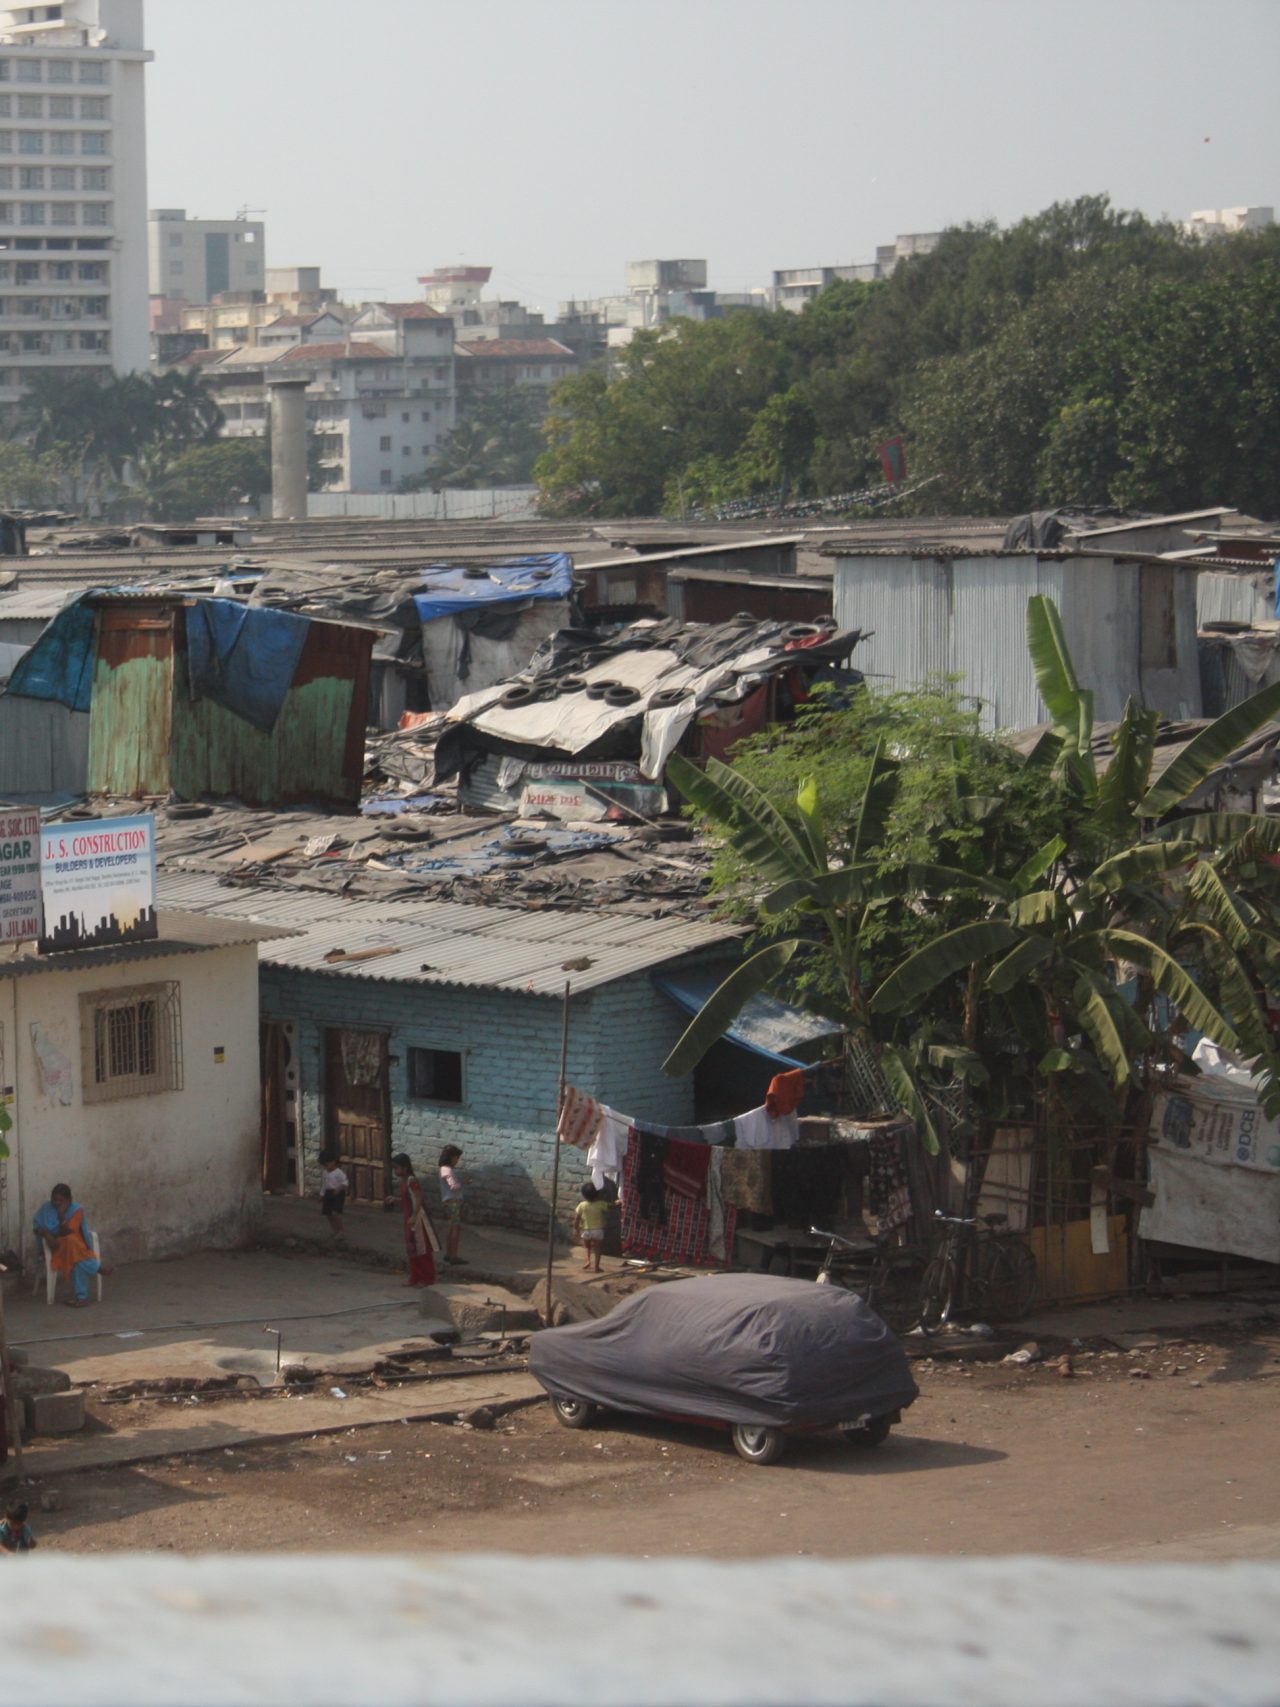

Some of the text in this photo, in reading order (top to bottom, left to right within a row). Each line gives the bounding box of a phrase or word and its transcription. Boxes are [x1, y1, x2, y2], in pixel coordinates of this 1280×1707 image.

[45, 831, 146, 860] J. S. CONSTRUCTION
[55, 860, 88, 873] BUILDERS
[94, 854, 137, 868] DEVELOPERS
[6, 918, 38, 938] JILANI
[1239, 1110, 1256, 1146] DCB
